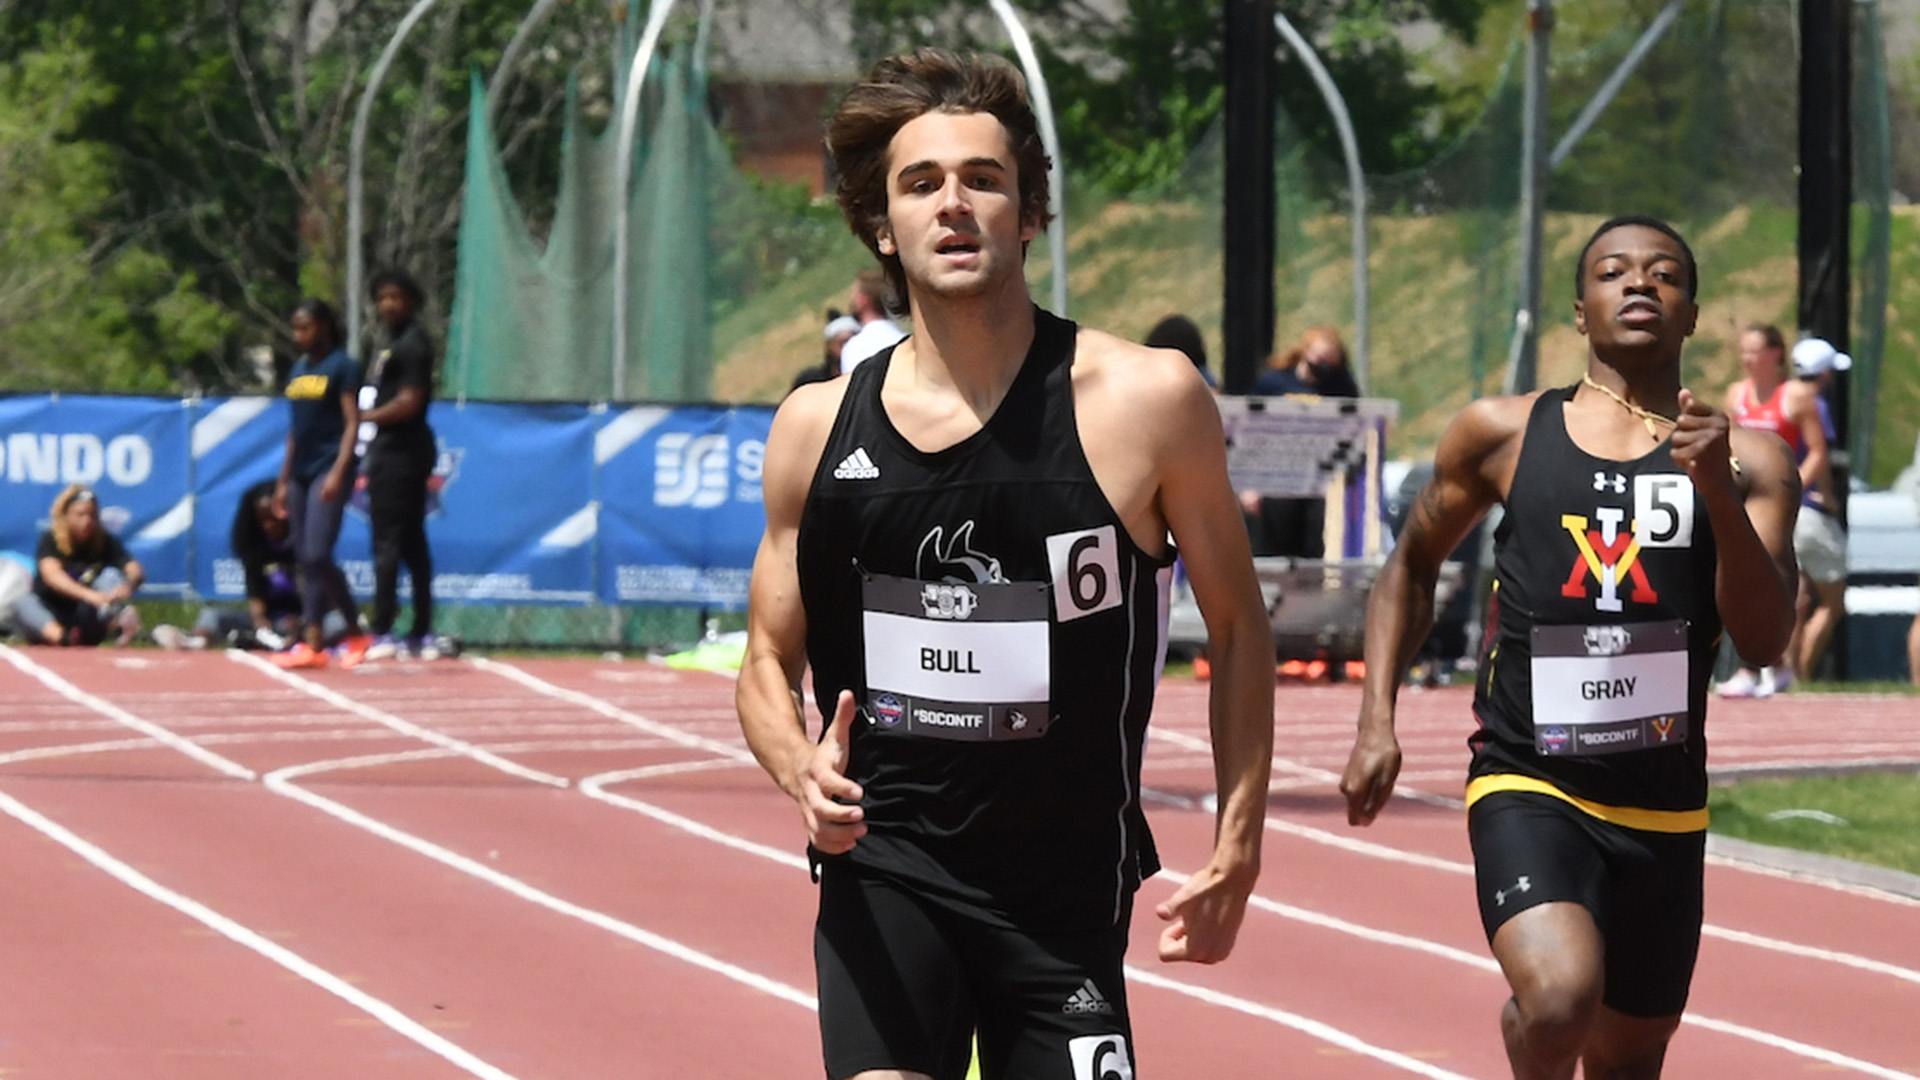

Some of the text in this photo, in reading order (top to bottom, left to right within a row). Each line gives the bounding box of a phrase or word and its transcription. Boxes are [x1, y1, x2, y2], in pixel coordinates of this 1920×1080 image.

[0, 433, 152, 486] NDO
[833, 466, 880, 480] adidas
[1649, 481, 1680, 543] 5
[1067, 535, 1107, 611] 6
[920, 647, 981, 674] BULL
[1581, 677, 1637, 700] GRAY
[913, 709, 983, 728] #SOCONTF
[1062, 1000, 1112, 1015] adidas
